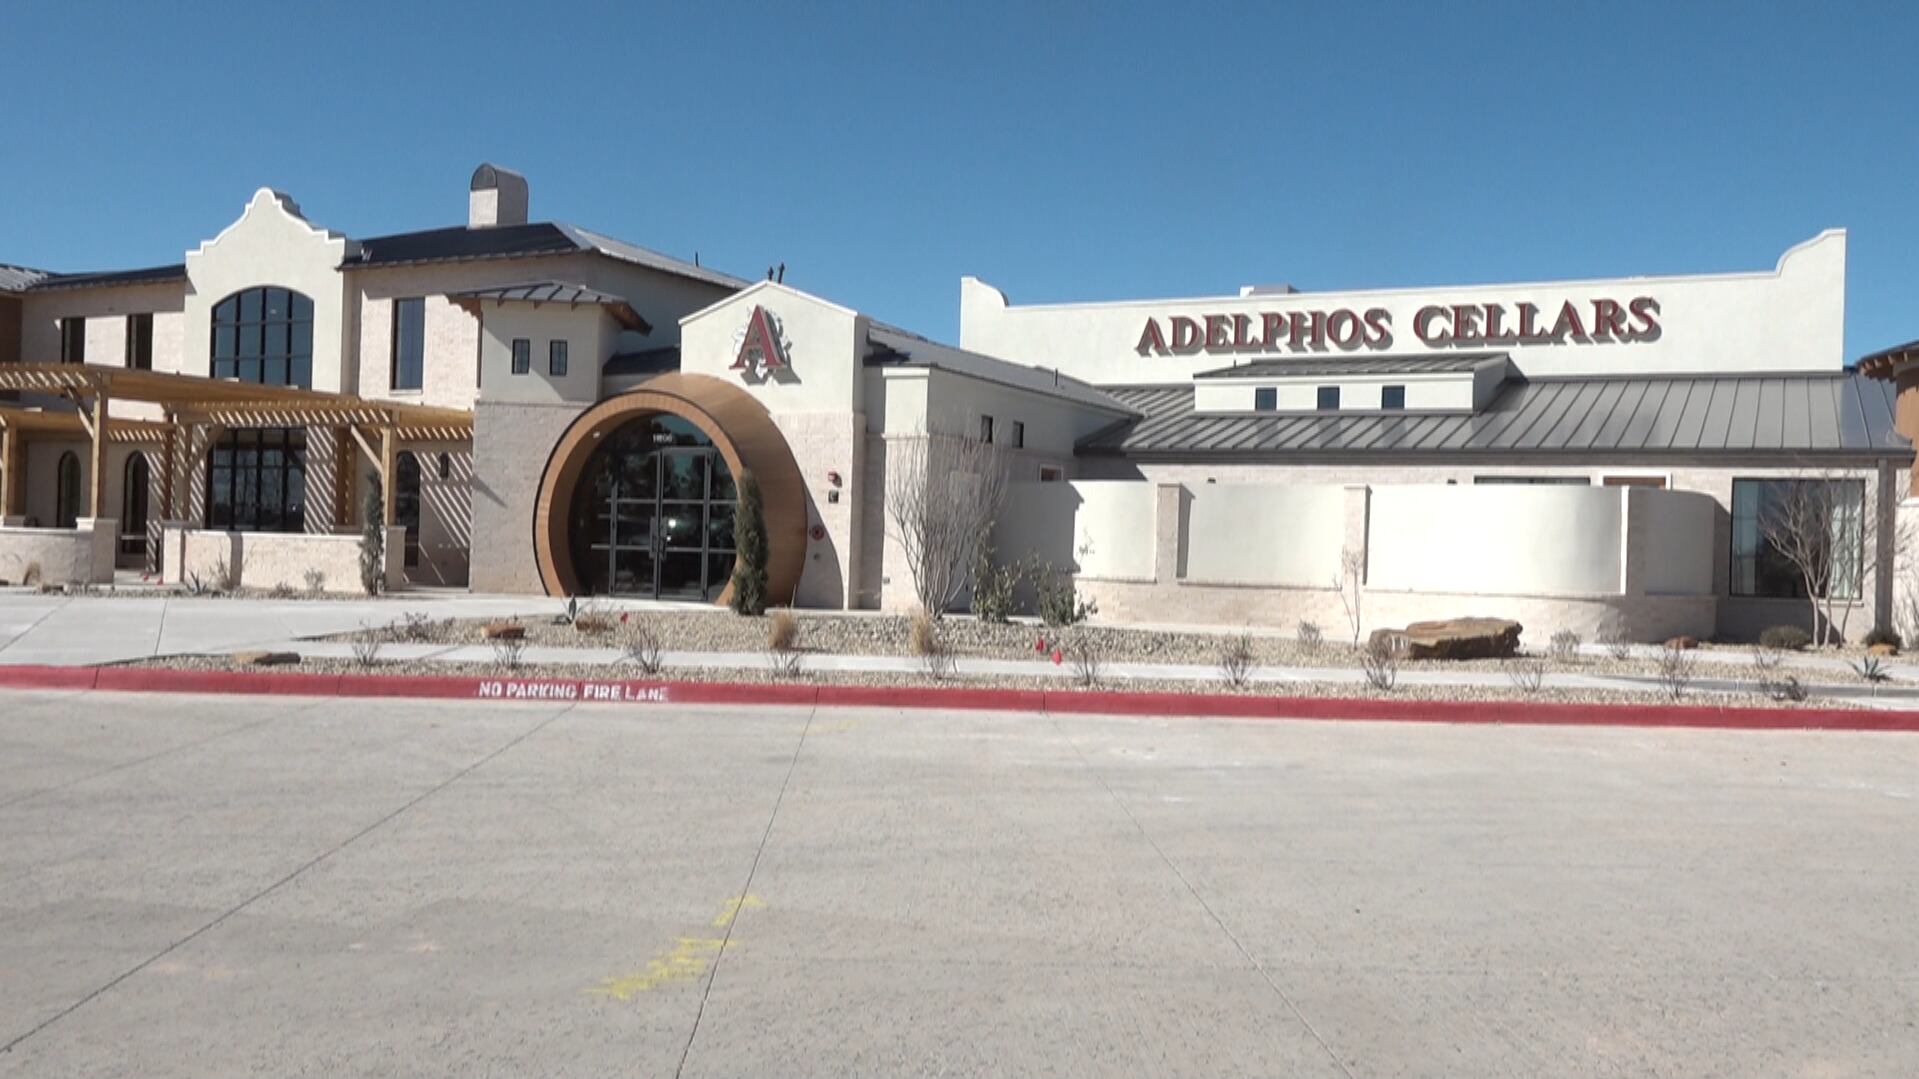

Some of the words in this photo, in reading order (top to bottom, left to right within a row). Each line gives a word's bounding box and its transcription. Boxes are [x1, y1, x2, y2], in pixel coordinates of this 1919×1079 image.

[728, 303, 788, 370] A
[1134, 307, 1394, 357] ADELPHOS
[1412, 296, 1663, 349] CELLARS
[478, 681, 502, 697] NO
[506, 683, 577, 699] PARKING
[583, 684, 621, 700] FIRE
[625, 685, 669, 701] LANE
